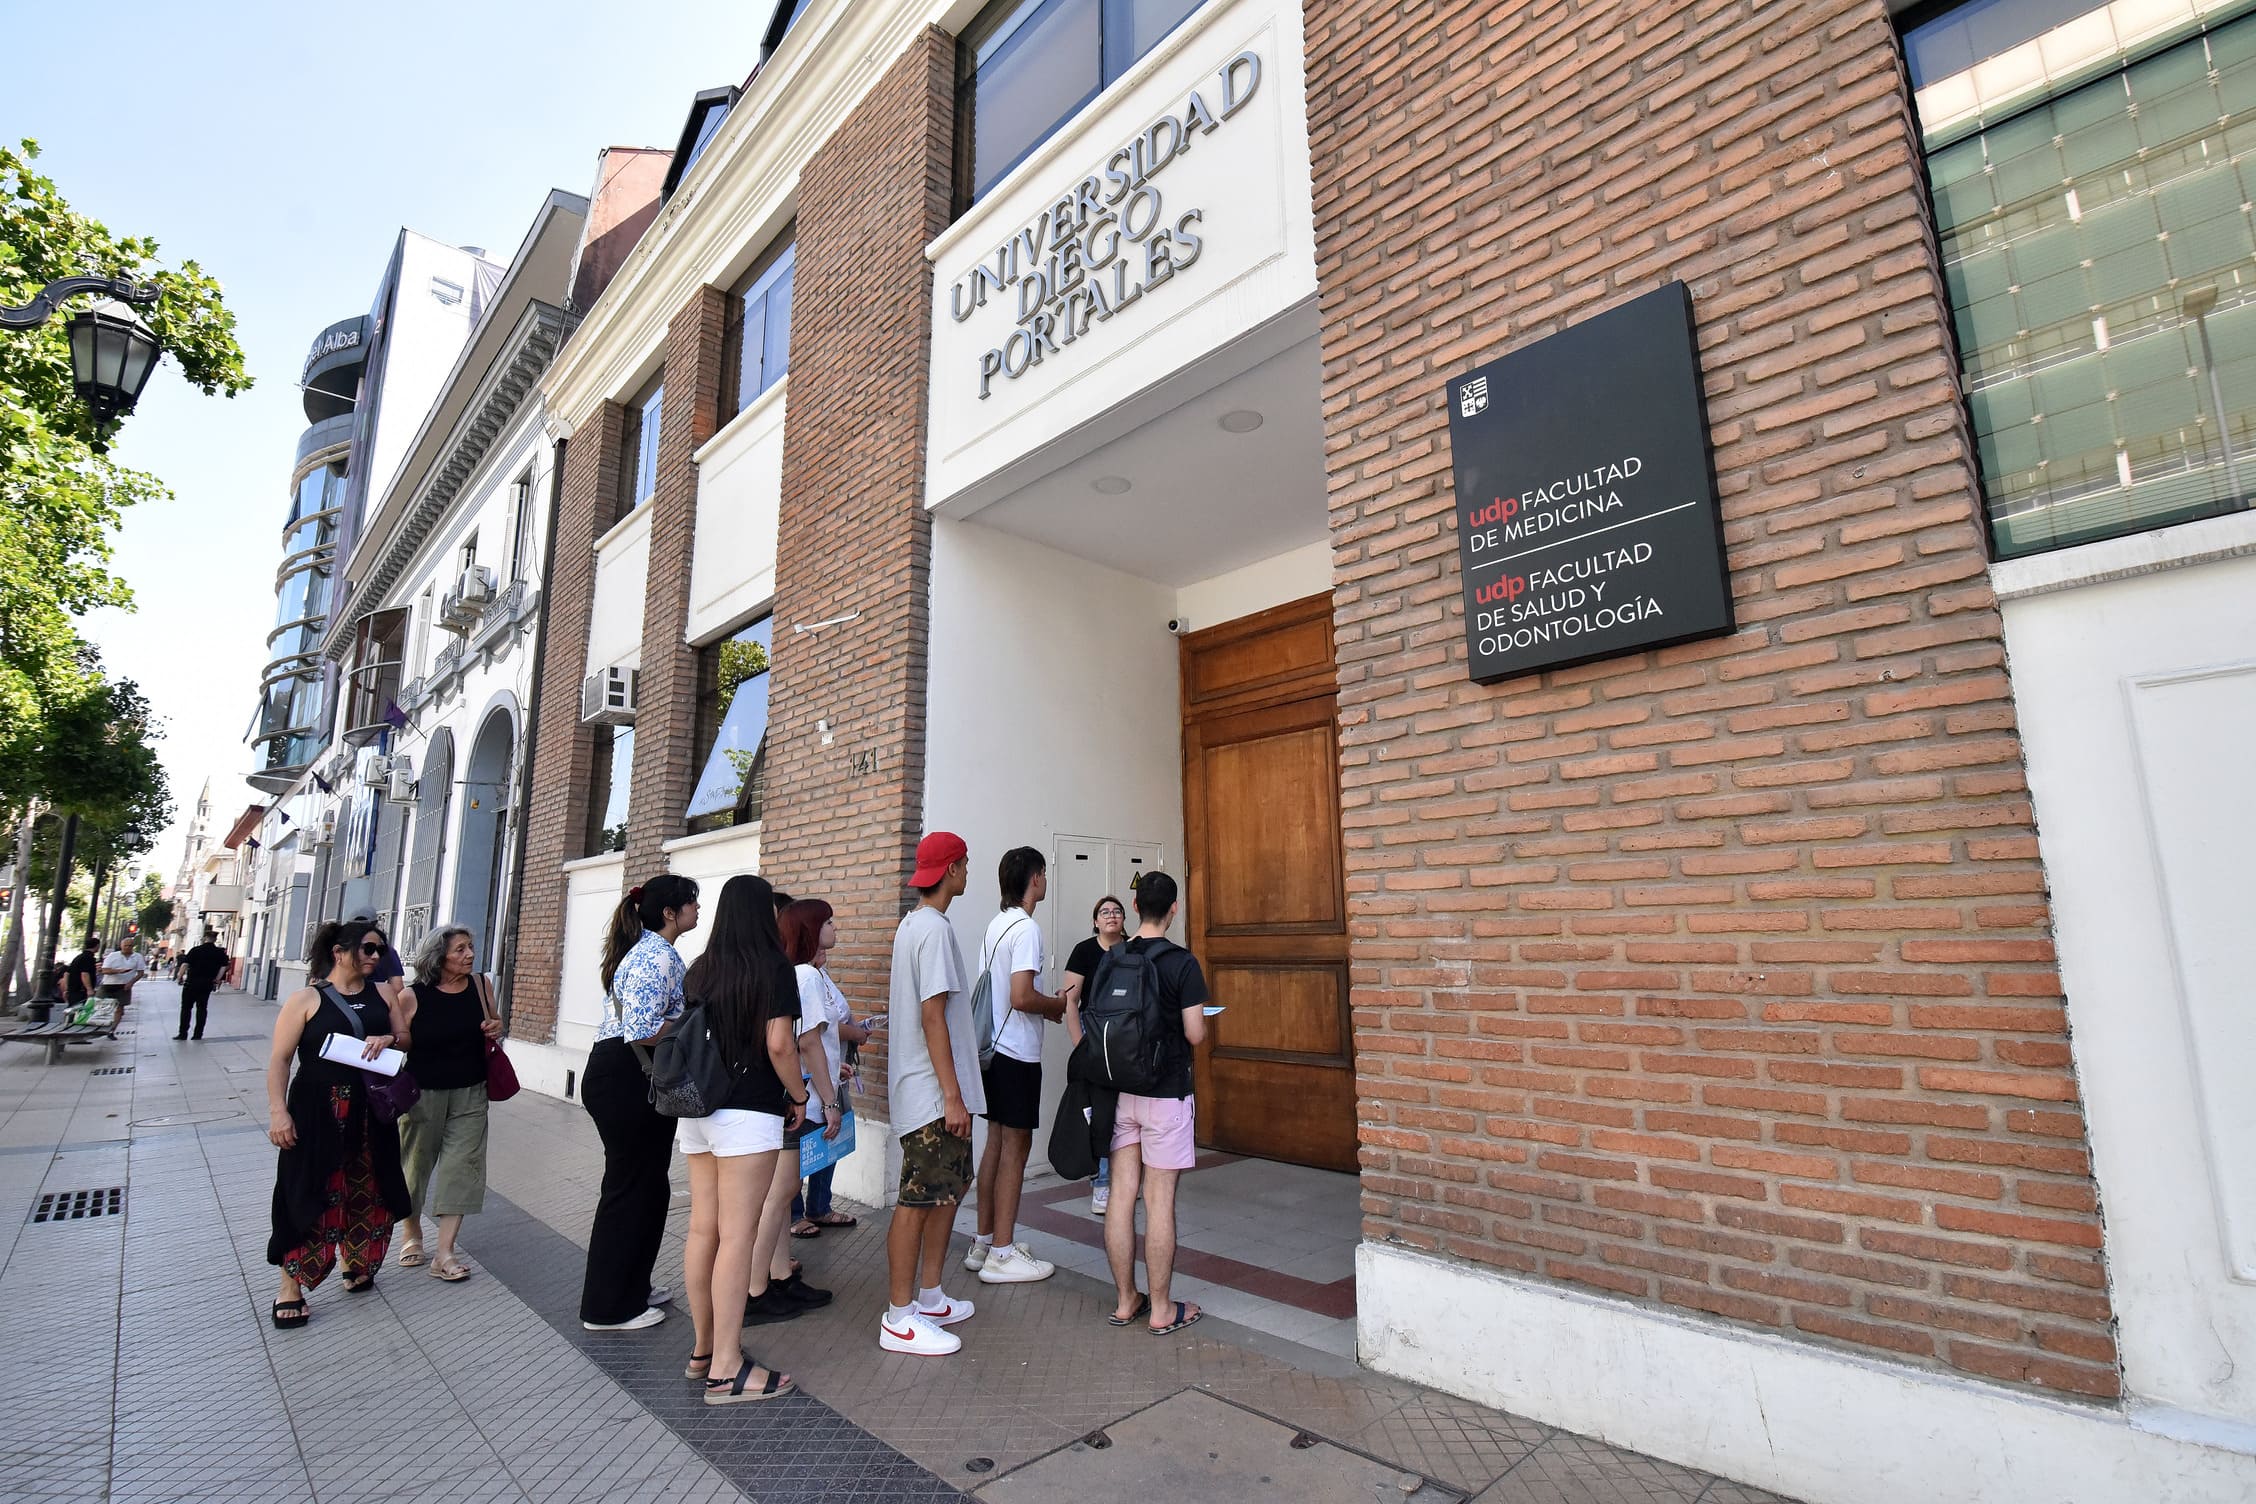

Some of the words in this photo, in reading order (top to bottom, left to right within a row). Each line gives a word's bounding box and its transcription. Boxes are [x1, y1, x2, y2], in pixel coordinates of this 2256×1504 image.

[951, 51, 1262, 322] UNIVERSIDAD
[1016, 185, 1162, 326] DIEGO
[978, 207, 1203, 400] PORTALES
[322, 331, 360, 355] Alba
[1469, 496, 1518, 528] udp
[1521, 456, 1642, 512] FACULTAD
[1470, 528, 1499, 552] DE
[1504, 490, 1623, 543] MEDICINA
[1475, 573, 1525, 605] udp
[1529, 541, 1653, 593] FACULTAD
[1477, 607, 1506, 631] DE
[1511, 587, 1586, 622] SALUD
[1590, 581, 1607, 602] Y
[1478, 596, 1663, 656] ODONTOLOGÍA
